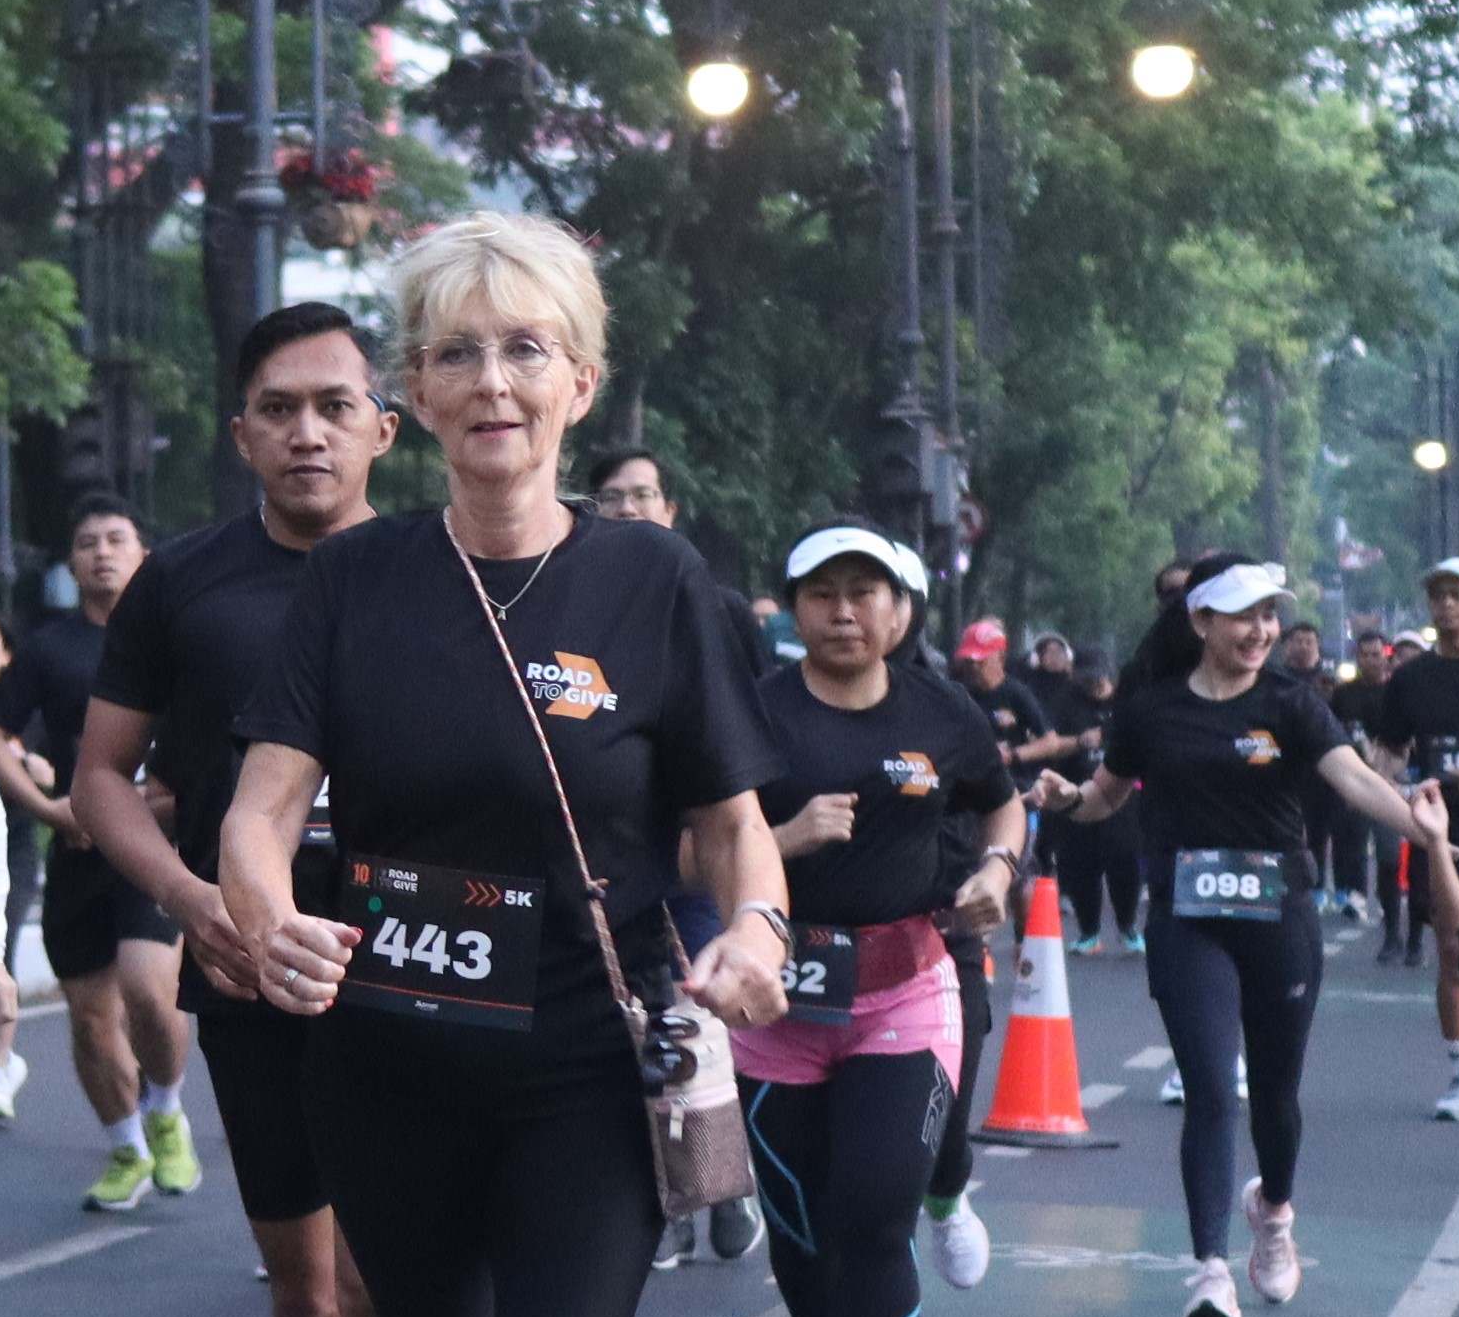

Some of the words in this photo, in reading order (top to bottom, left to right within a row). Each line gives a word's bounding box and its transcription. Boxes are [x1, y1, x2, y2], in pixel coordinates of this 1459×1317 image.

[526, 662, 593, 686] ROAD
[532, 681, 563, 701] TO
[564, 687, 619, 712] GIVE
[883, 759, 926, 773] ROAD
[388, 868, 419, 882] ROAD
[392, 879, 419, 893] GIVE
[1195, 872, 1261, 900] 098
[503, 889, 533, 908] 5K
[371, 915, 494, 981] 443
